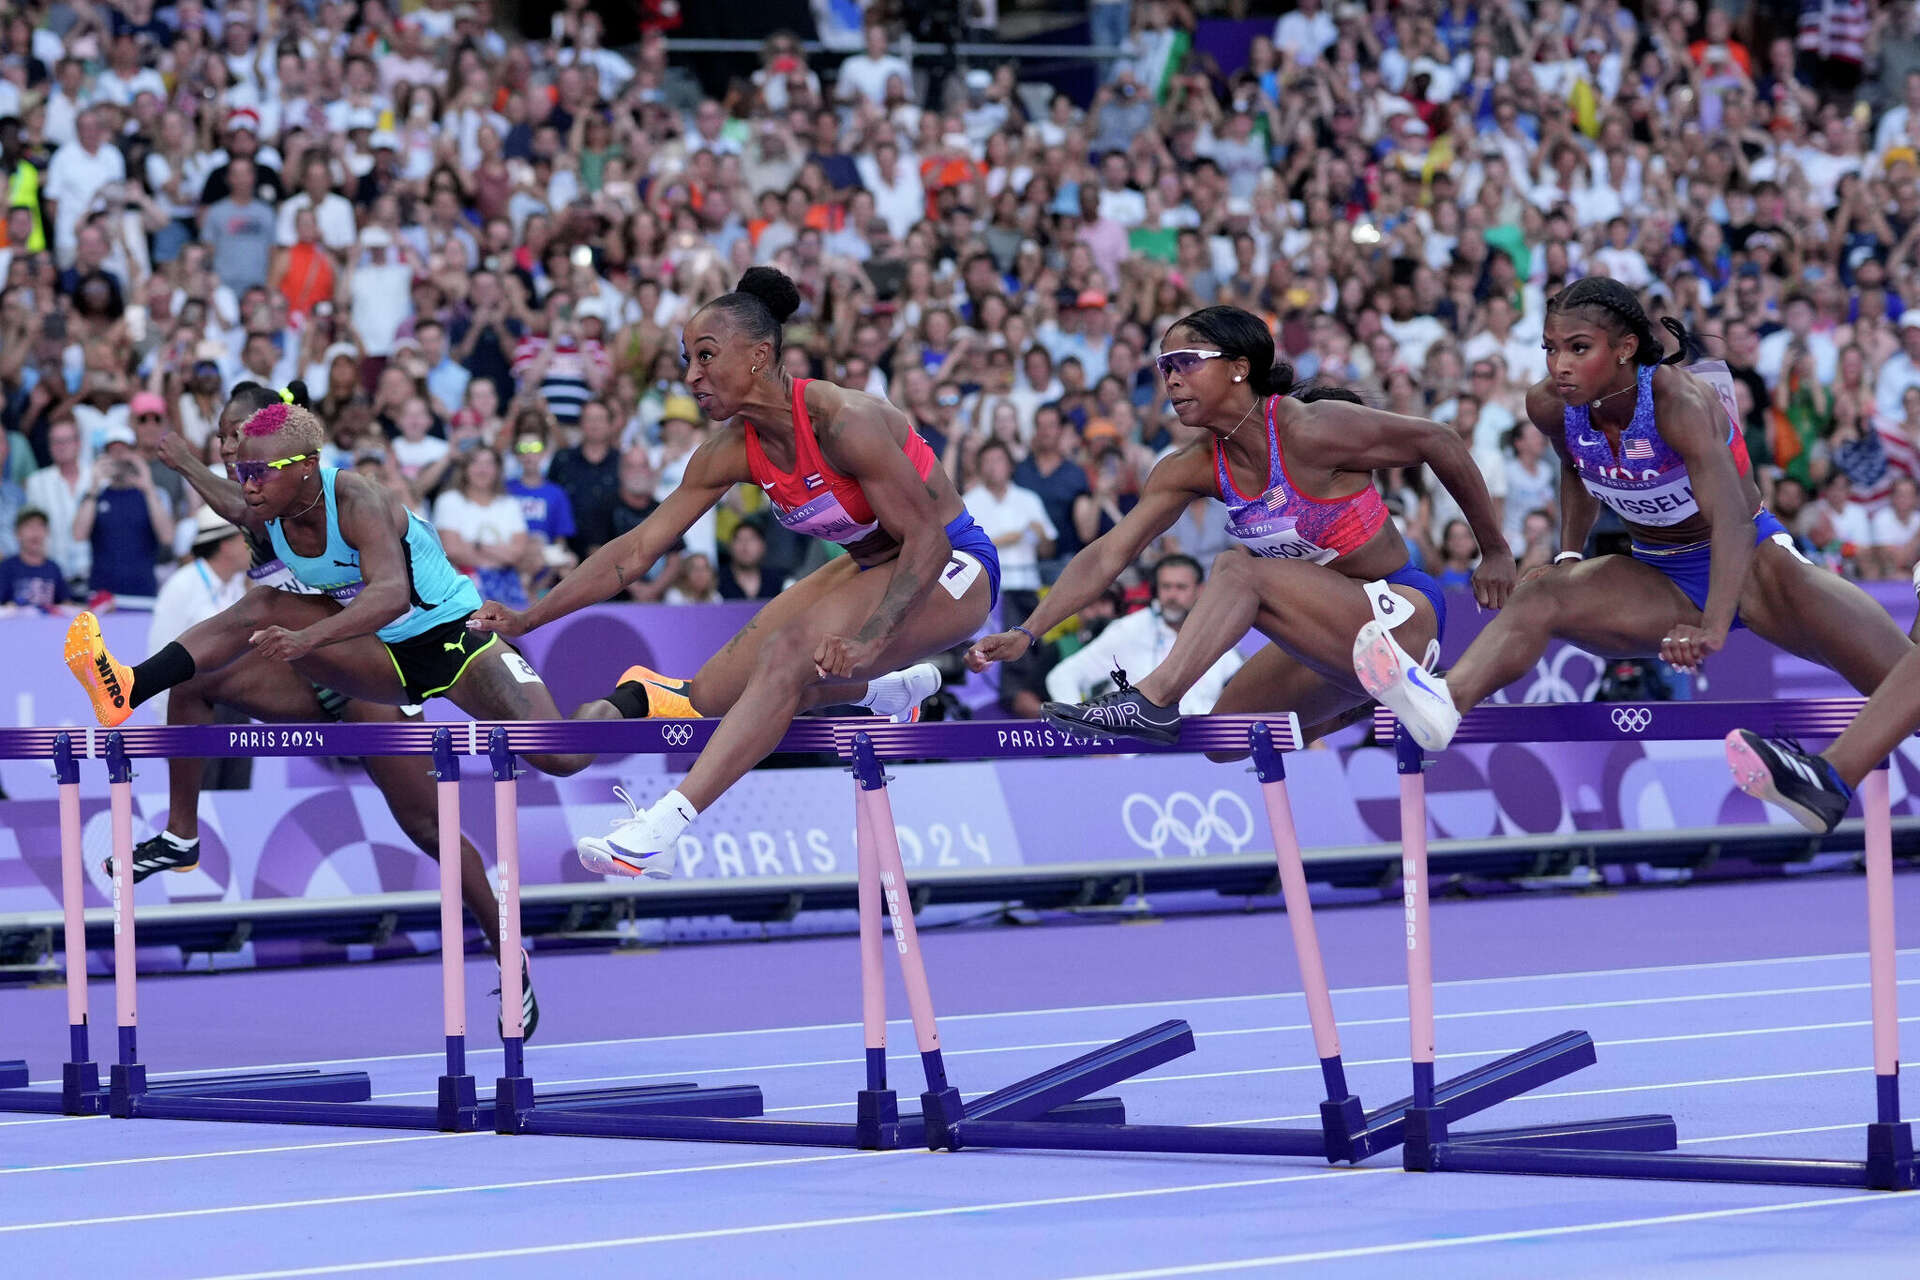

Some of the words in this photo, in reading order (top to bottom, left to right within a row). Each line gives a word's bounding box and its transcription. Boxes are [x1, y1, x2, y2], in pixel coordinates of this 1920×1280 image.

[946, 556, 969, 580] 7
[1257, 540, 1317, 559] NSON
[95, 649, 125, 709] NITRO
[1080, 701, 1146, 728] AIR
[281, 731, 324, 747] 2024
[853, 822, 993, 867] 024
[499, 879, 509, 942] MONDO
[884, 889, 908, 954] MONDO
[1403, 879, 1417, 950] MONDO
